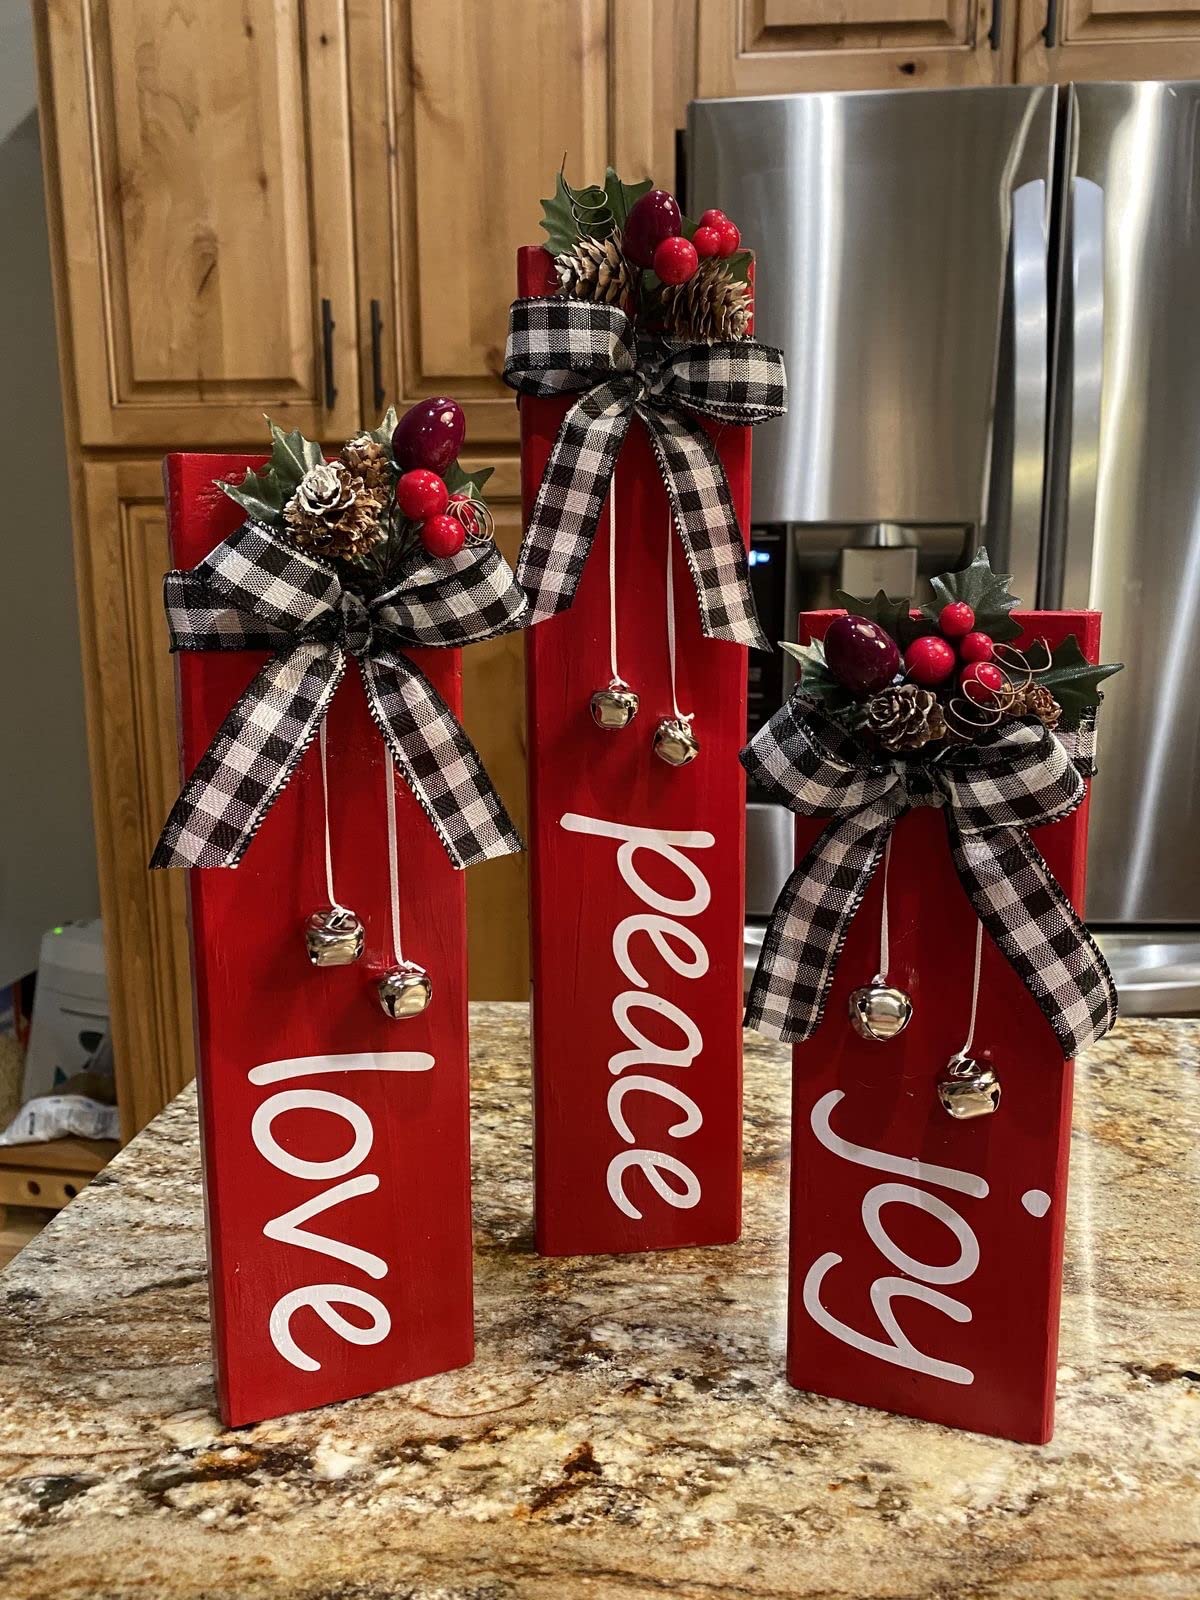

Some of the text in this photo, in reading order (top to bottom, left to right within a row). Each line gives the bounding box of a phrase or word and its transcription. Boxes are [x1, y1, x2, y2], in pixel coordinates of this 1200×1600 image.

[559, 812, 716, 1220] peace
[248, 1051, 436, 1372] love
[803, 1089, 1052, 1386] joy
